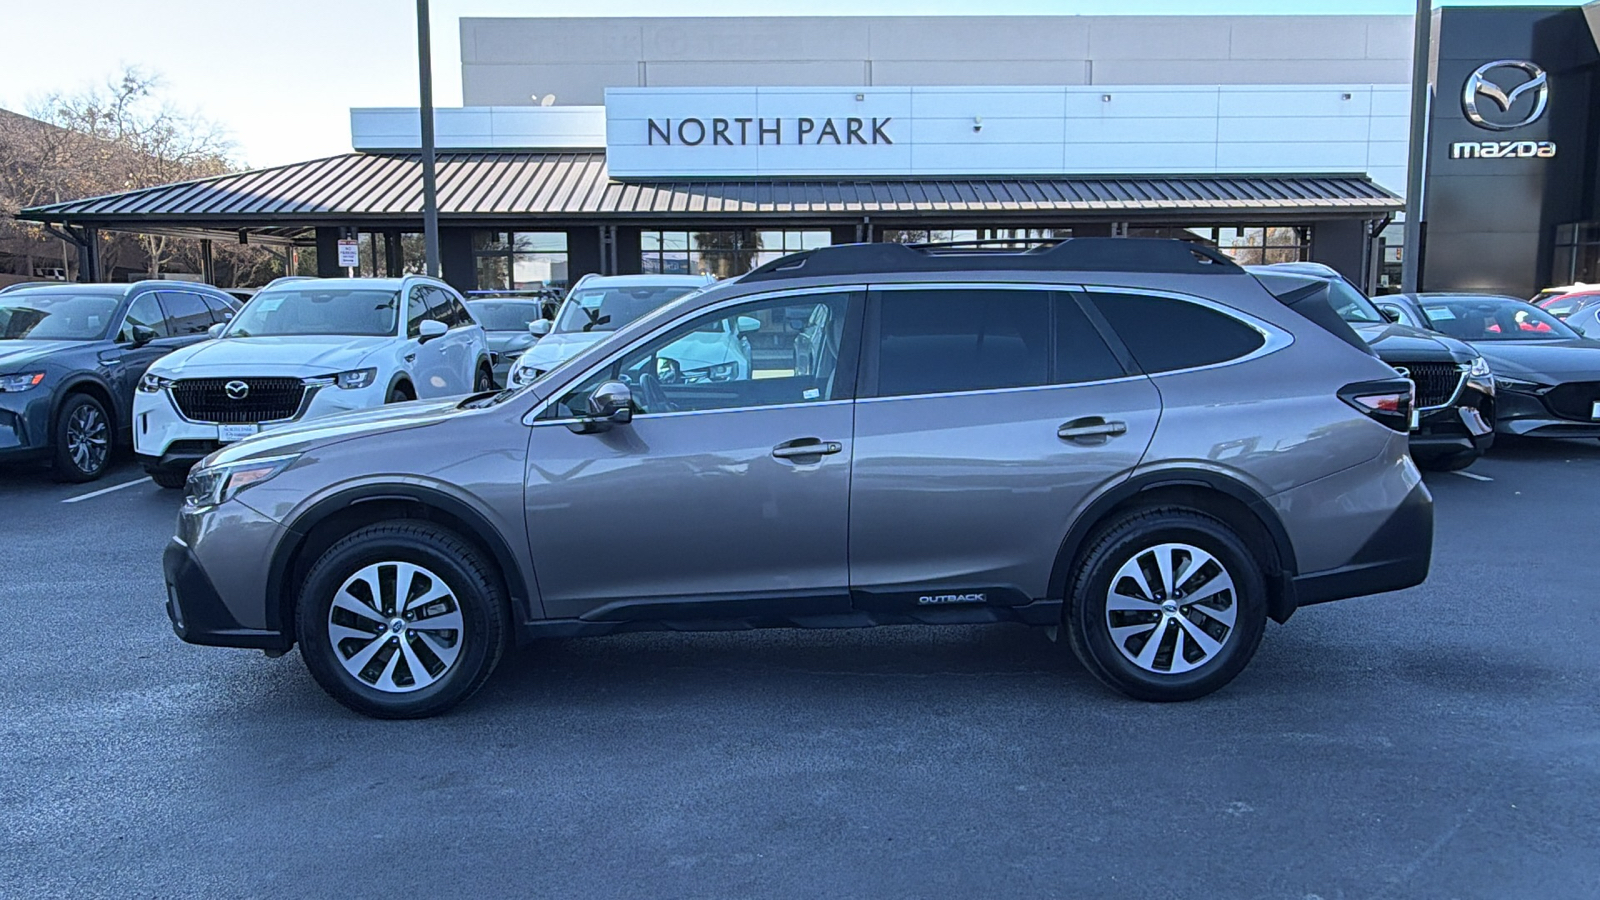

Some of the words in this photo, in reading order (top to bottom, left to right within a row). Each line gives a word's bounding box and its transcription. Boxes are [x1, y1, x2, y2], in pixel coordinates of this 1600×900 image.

[647, 117, 782, 146] NORTH
[797, 116, 894, 145] PARK
[919, 593, 984, 603] OUTBACK
